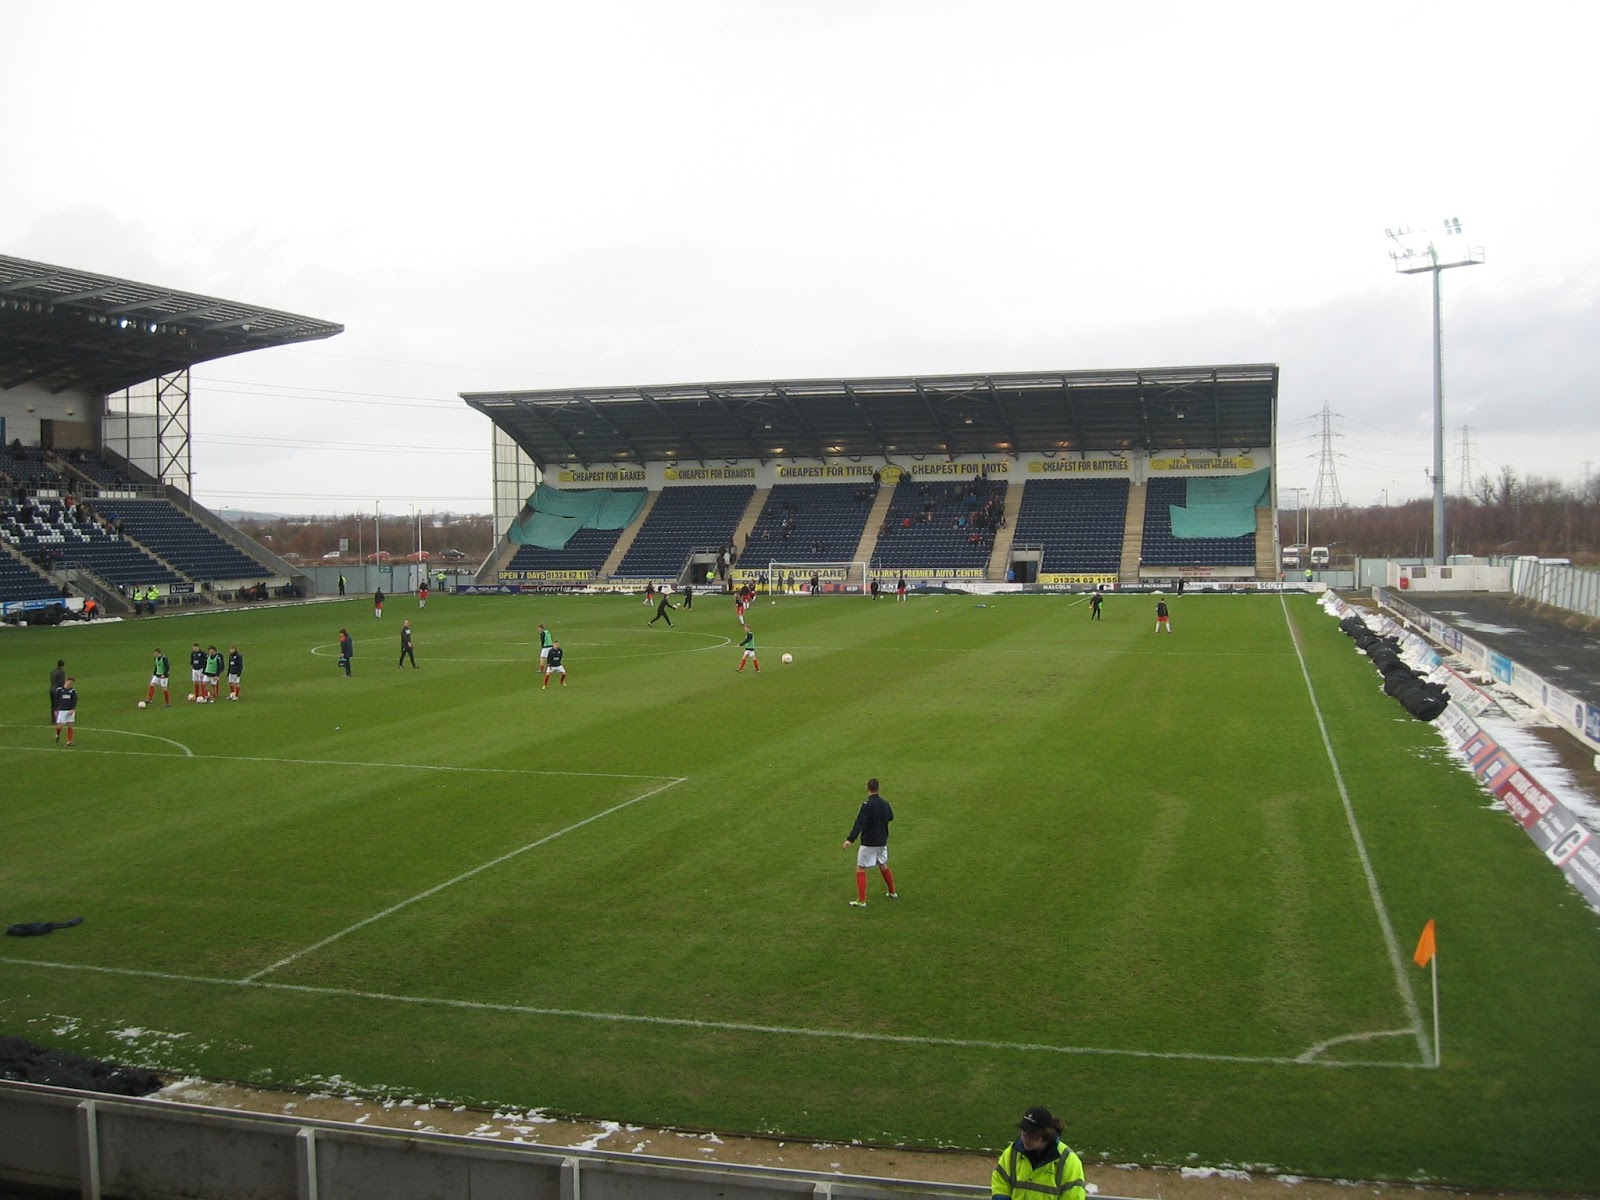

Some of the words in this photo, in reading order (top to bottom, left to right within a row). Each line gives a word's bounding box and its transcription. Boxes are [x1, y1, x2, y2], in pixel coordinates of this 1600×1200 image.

[780, 467, 824, 477] CHEAPEST
[827, 466, 843, 477] FOR
[845, 465, 874, 476] TYRES
[911, 464, 958, 475] CHEAPEST
[961, 463, 979, 474] FOR
[981, 463, 1008, 473] MOTS
[1043, 461, 1076, 472] CHEAPEST
[1078, 461, 1092, 471] FOR
[1093, 460, 1128, 471] BATTERIES
[572, 472, 604, 482] CHEAPEST
[606, 471, 619, 481] FOR
[620, 471, 646, 481] BRAKES
[678, 469, 709, 479] CHEAPEST
[711, 469, 723, 479] FOR
[724, 468, 755, 479] EXHAUSTS
[742, 570, 785, 578] FARMER
[789, 569, 844, 578] AUTOCARE
[866, 569, 901, 577] FALKIRK'S
[902, 569, 934, 577] PREMIER
[936, 569, 955, 577] AUTO
[956, 569, 983, 577] CENTRE
